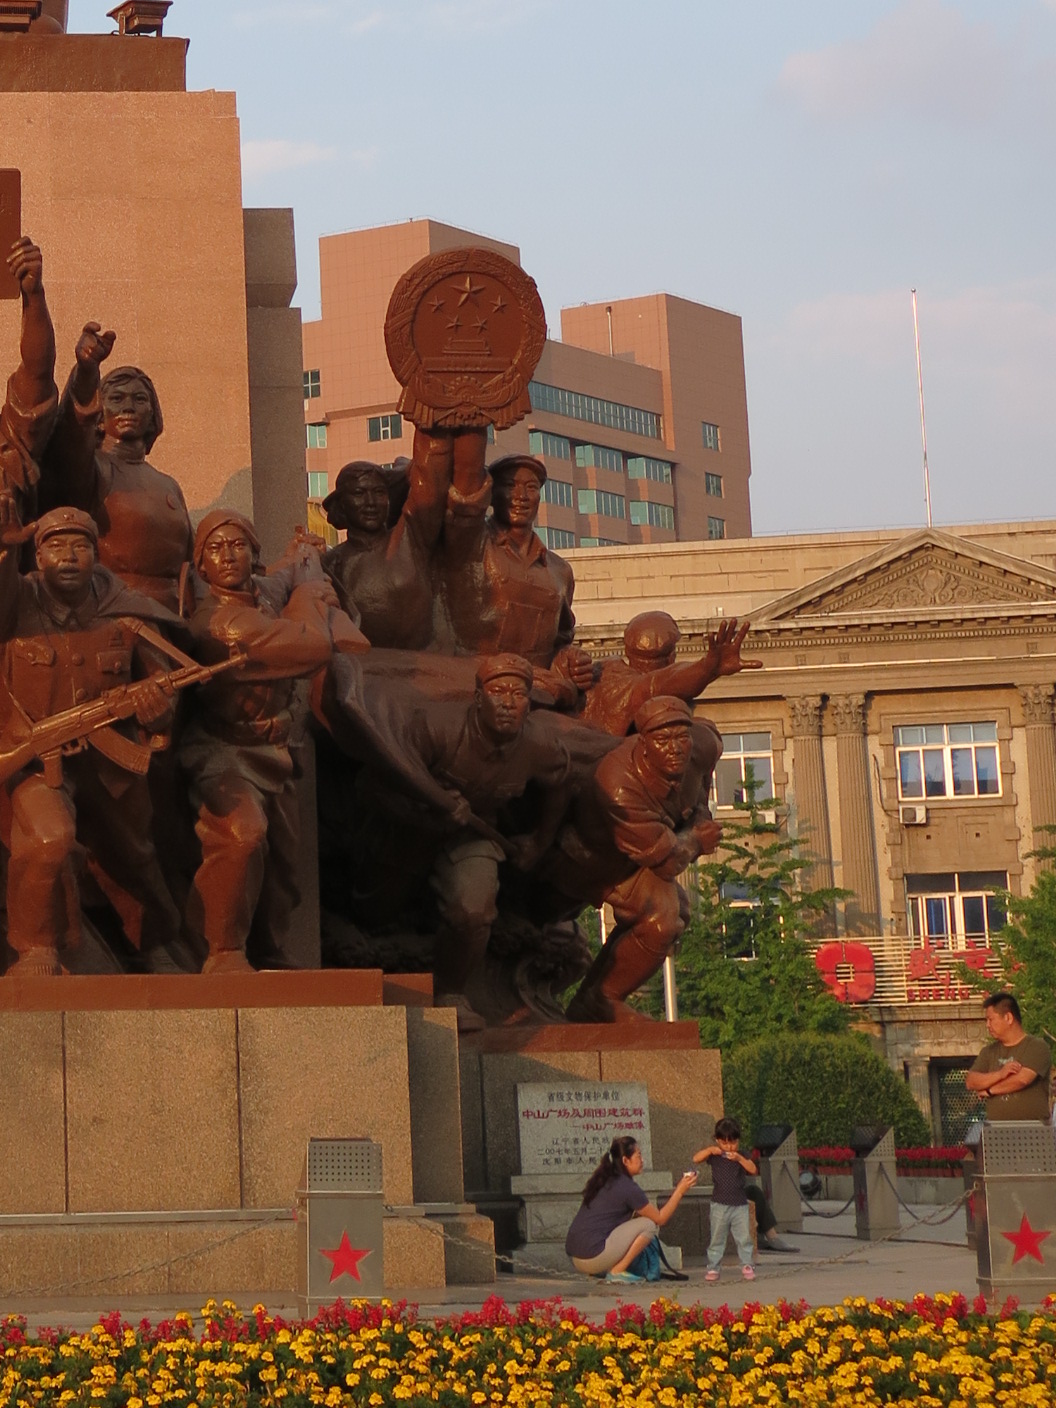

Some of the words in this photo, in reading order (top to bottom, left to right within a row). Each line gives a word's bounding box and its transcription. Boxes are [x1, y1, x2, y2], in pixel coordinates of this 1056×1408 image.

[907, 989, 970, 1000] SHENG
[548, 1090, 619, 1102] 省级文物保护单位
[522, 1107, 645, 1120] 中山广场及周围建筑群
